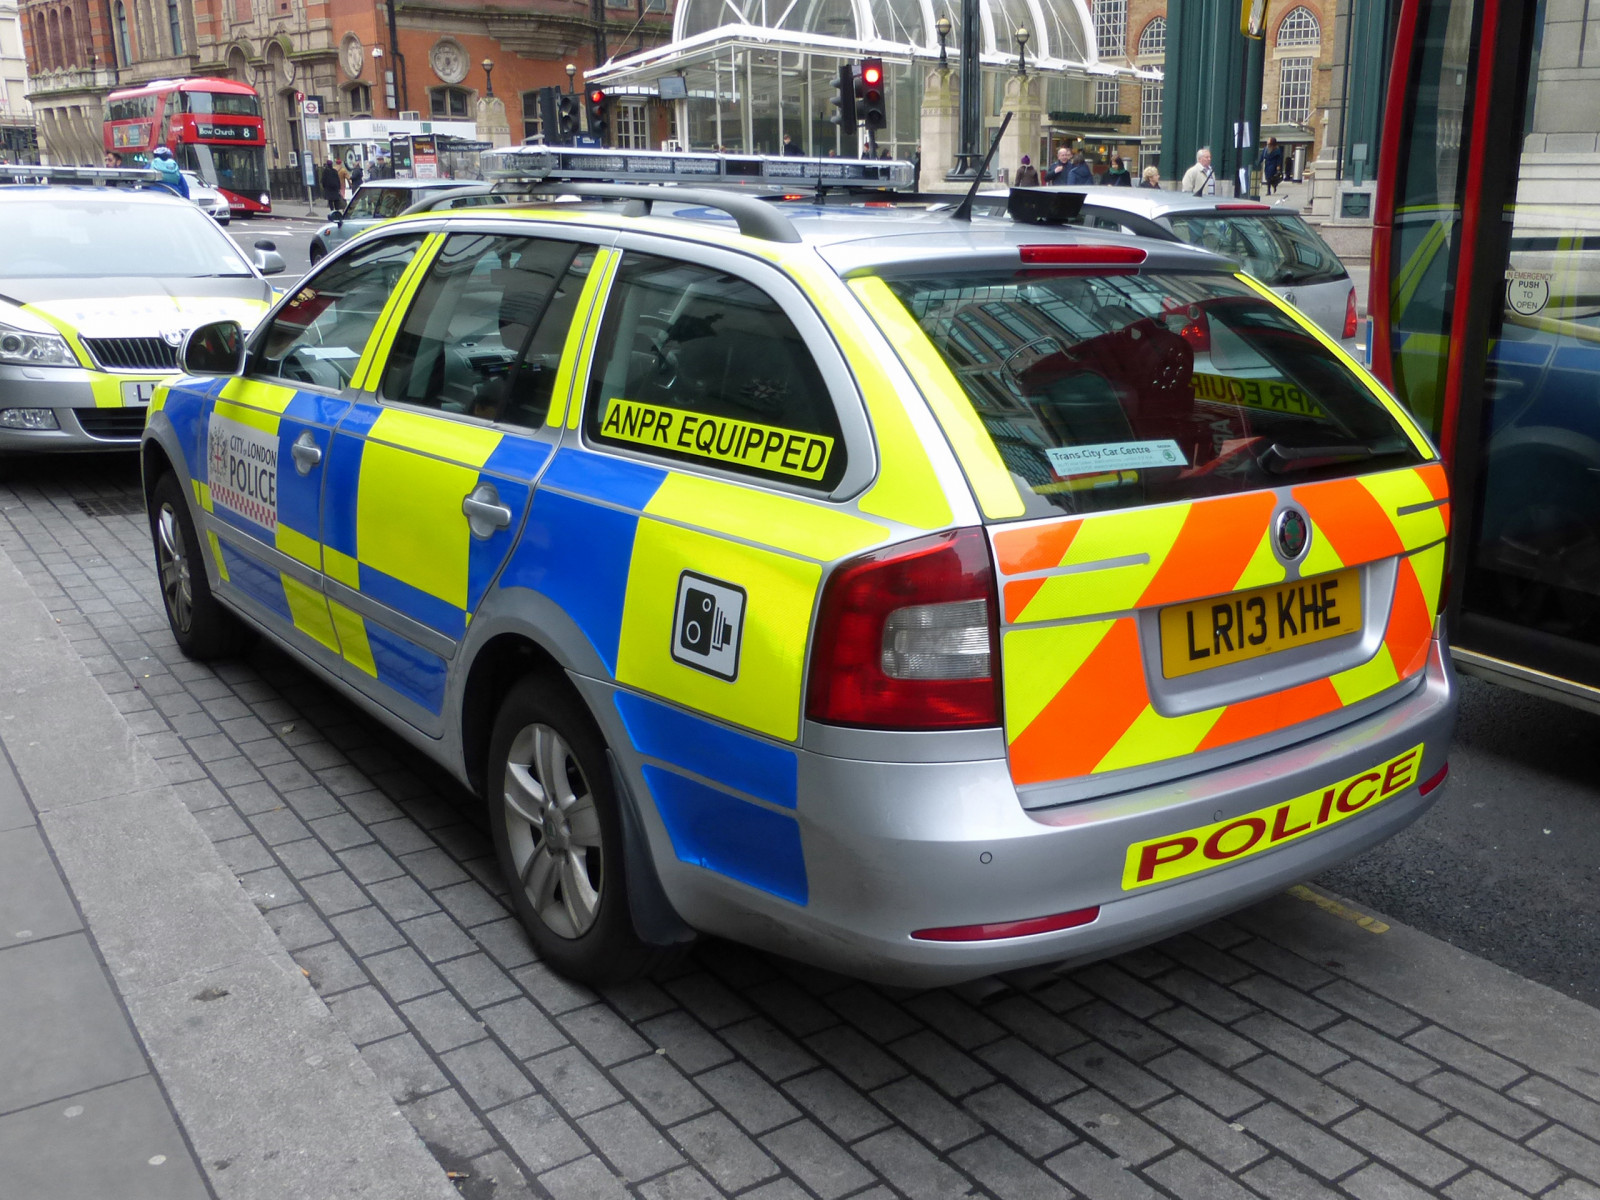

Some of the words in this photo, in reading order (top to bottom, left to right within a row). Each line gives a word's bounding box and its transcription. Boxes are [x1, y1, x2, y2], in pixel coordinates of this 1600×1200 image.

[199, 127, 213, 135] Bow
[214, 128, 235, 136] Church
[243, 127, 250, 138] 8
[1507, 271, 1514, 279] IN
[1514, 271, 1553, 281] EMERGENCY
[1518, 280, 1540, 289] PUSH
[1523, 290, 1534, 299] TO
[1516, 301, 1538, 309] OPEN
[603, 403, 674, 443] ANPR
[676, 416, 828, 474] EQUIPPED
[230, 435, 245, 454] CITY
[247, 441, 277, 468] LONDON
[1053, 451, 1081, 461] Trans
[1081, 449, 1101, 459] City
[1103, 447, 1119, 457] Car
[1120, 446, 1151, 456] Centre
[230, 455, 276, 507] POLICE
[1186, 596, 1268, 661] LR13
[1276, 579, 1341, 639] KHE
[1136, 750, 1418, 883] POLICE
